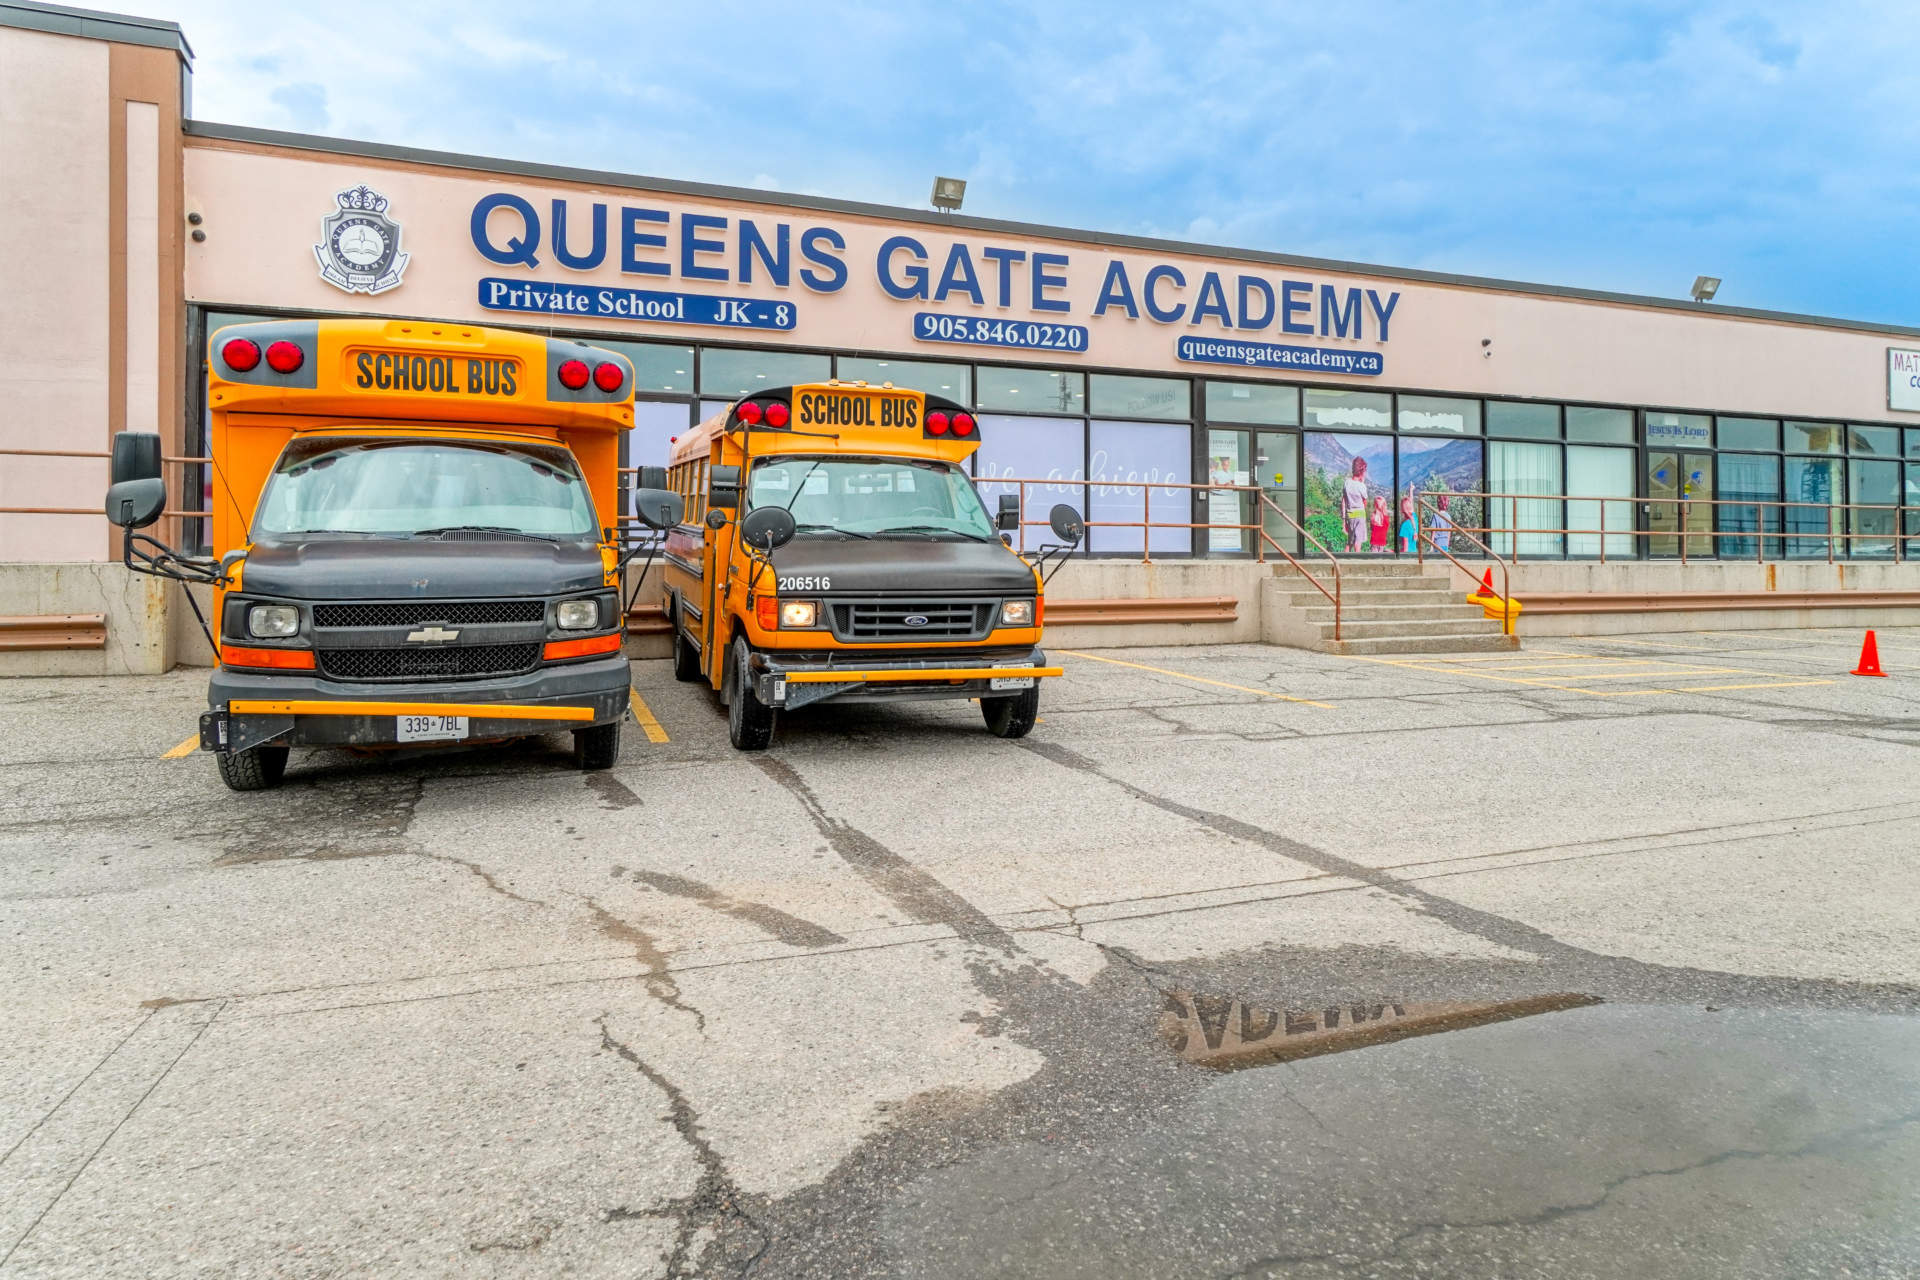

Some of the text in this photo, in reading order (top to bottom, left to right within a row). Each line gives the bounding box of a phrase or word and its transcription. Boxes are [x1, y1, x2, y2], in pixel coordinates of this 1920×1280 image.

[332, 219, 368, 240] QUEENS
[335, 251, 385, 271] ACADEMY
[470, 193, 1401, 342] QUEENS GATE ACADEMY
[488, 281, 590, 313] Private
[598, 291, 685, 319] School
[712, 301, 752, 324] JK
[775, 305, 789, 327] 8
[922, 315, 1082, 349] 905.846.0220
[1182, 340, 1379, 372] queensgateacademy.ca
[1894, 352, 1920, 372] MAT
[356, 352, 517, 396] SCHOOL BUS
[800, 394, 918, 428] SCHOOL BUS
[1046, 450, 1182, 497] achieve
[778, 576, 831, 591] 206516
[405, 717, 430, 733] 339
